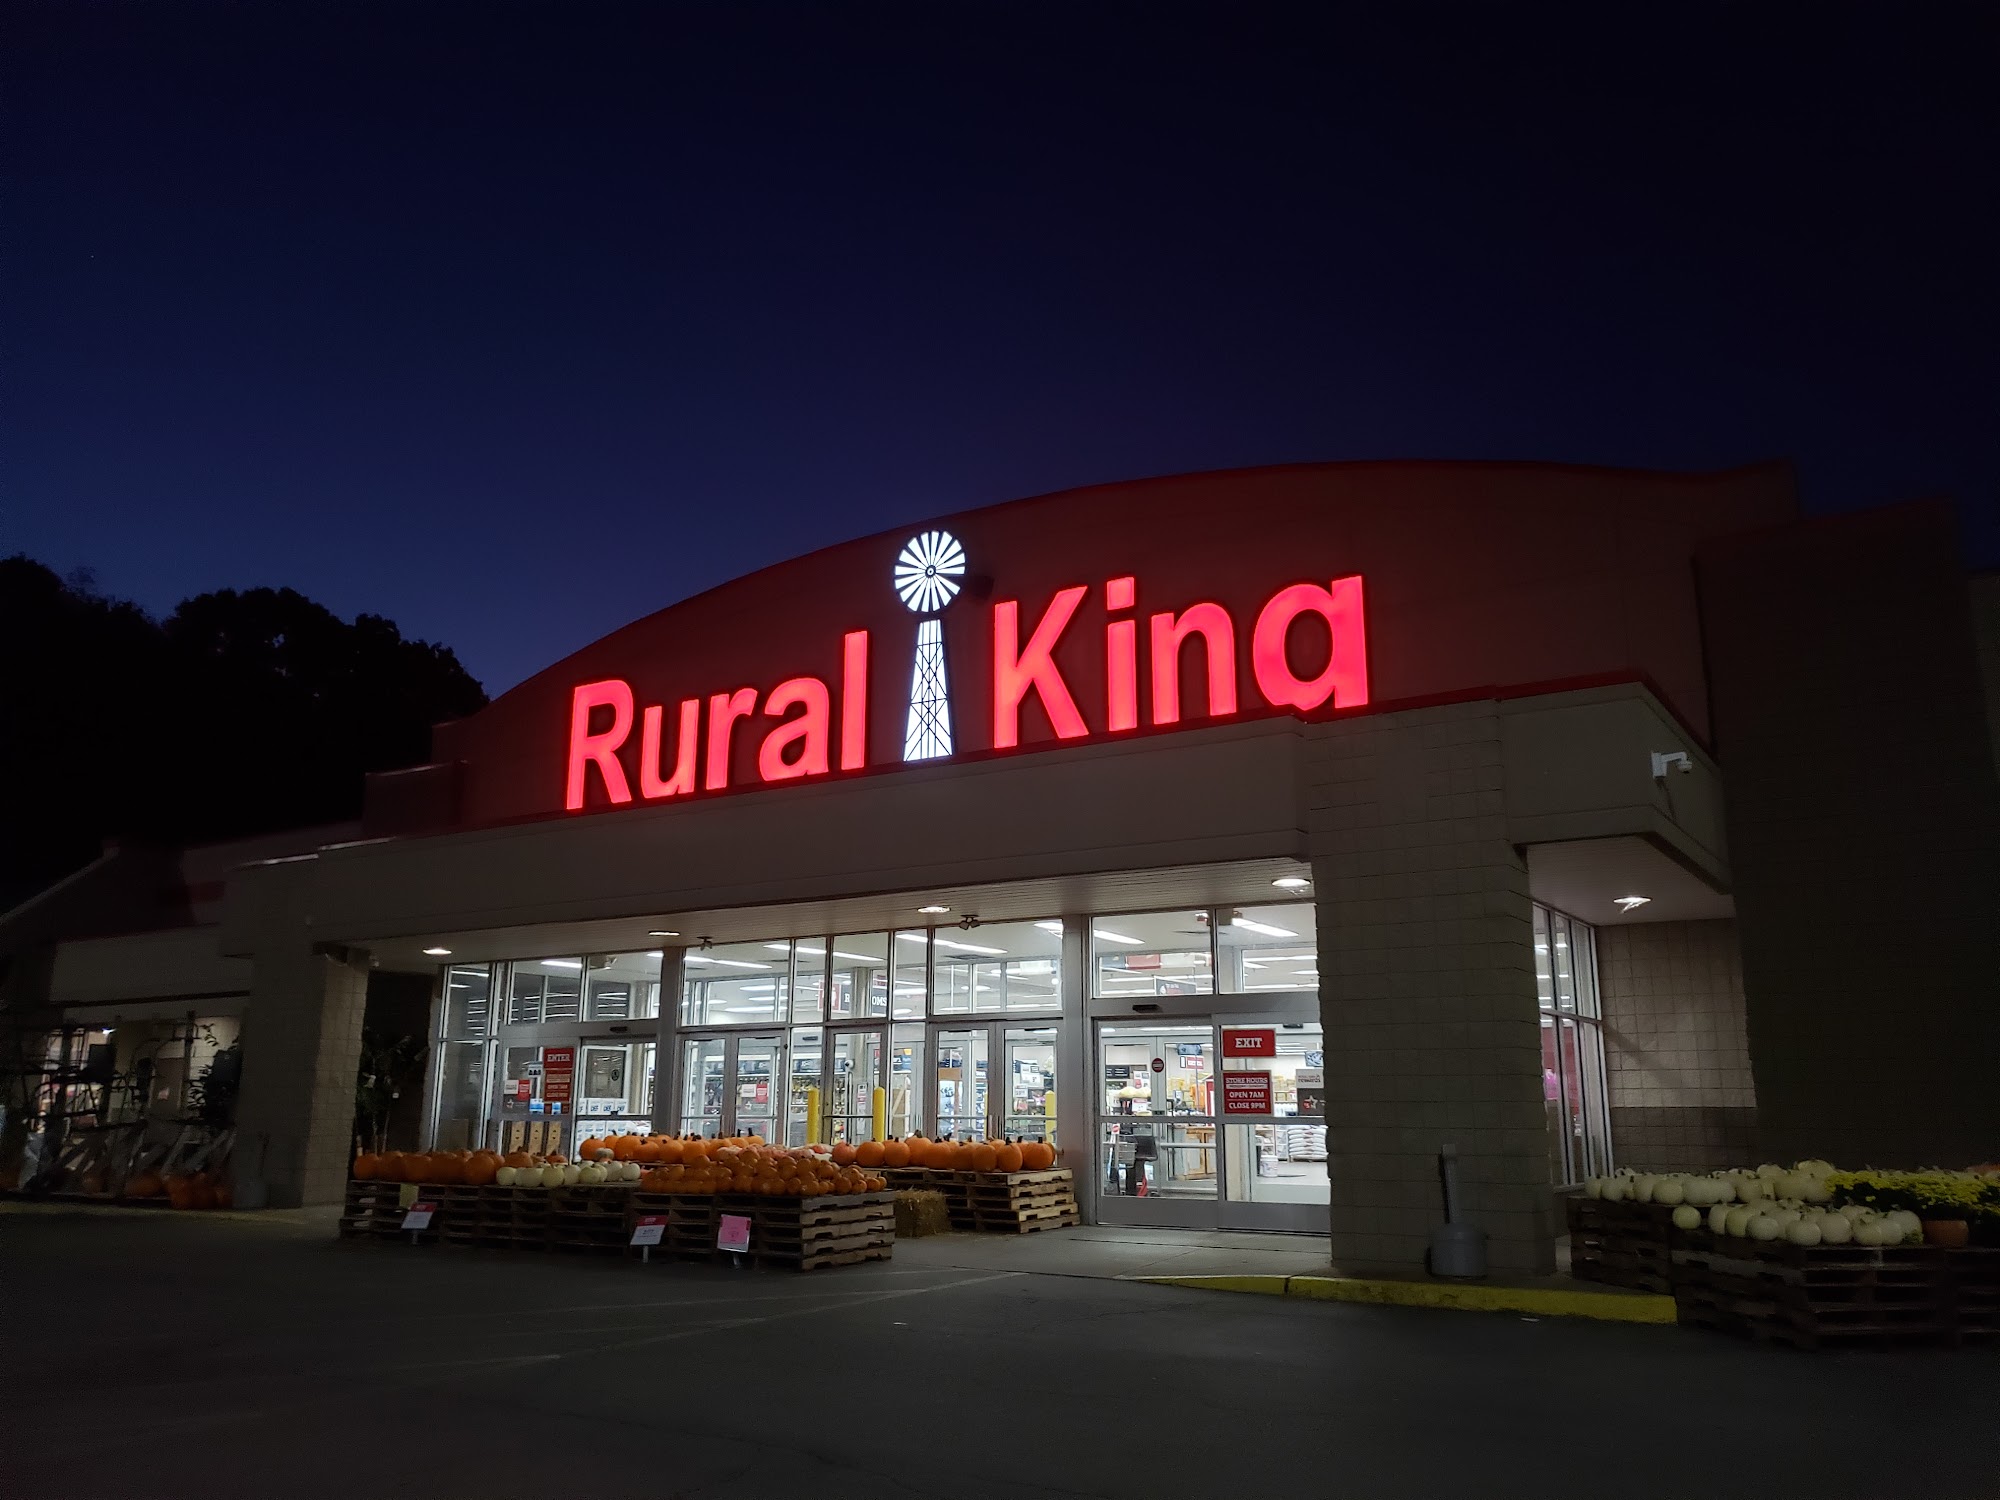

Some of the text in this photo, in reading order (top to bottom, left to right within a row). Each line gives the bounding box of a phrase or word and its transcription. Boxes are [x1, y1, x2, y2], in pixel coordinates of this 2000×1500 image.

[565, 629, 869, 811] Rural
[1235, 1037, 1263, 1048] EXIT
[547, 1053, 570, 1061] ENTER
